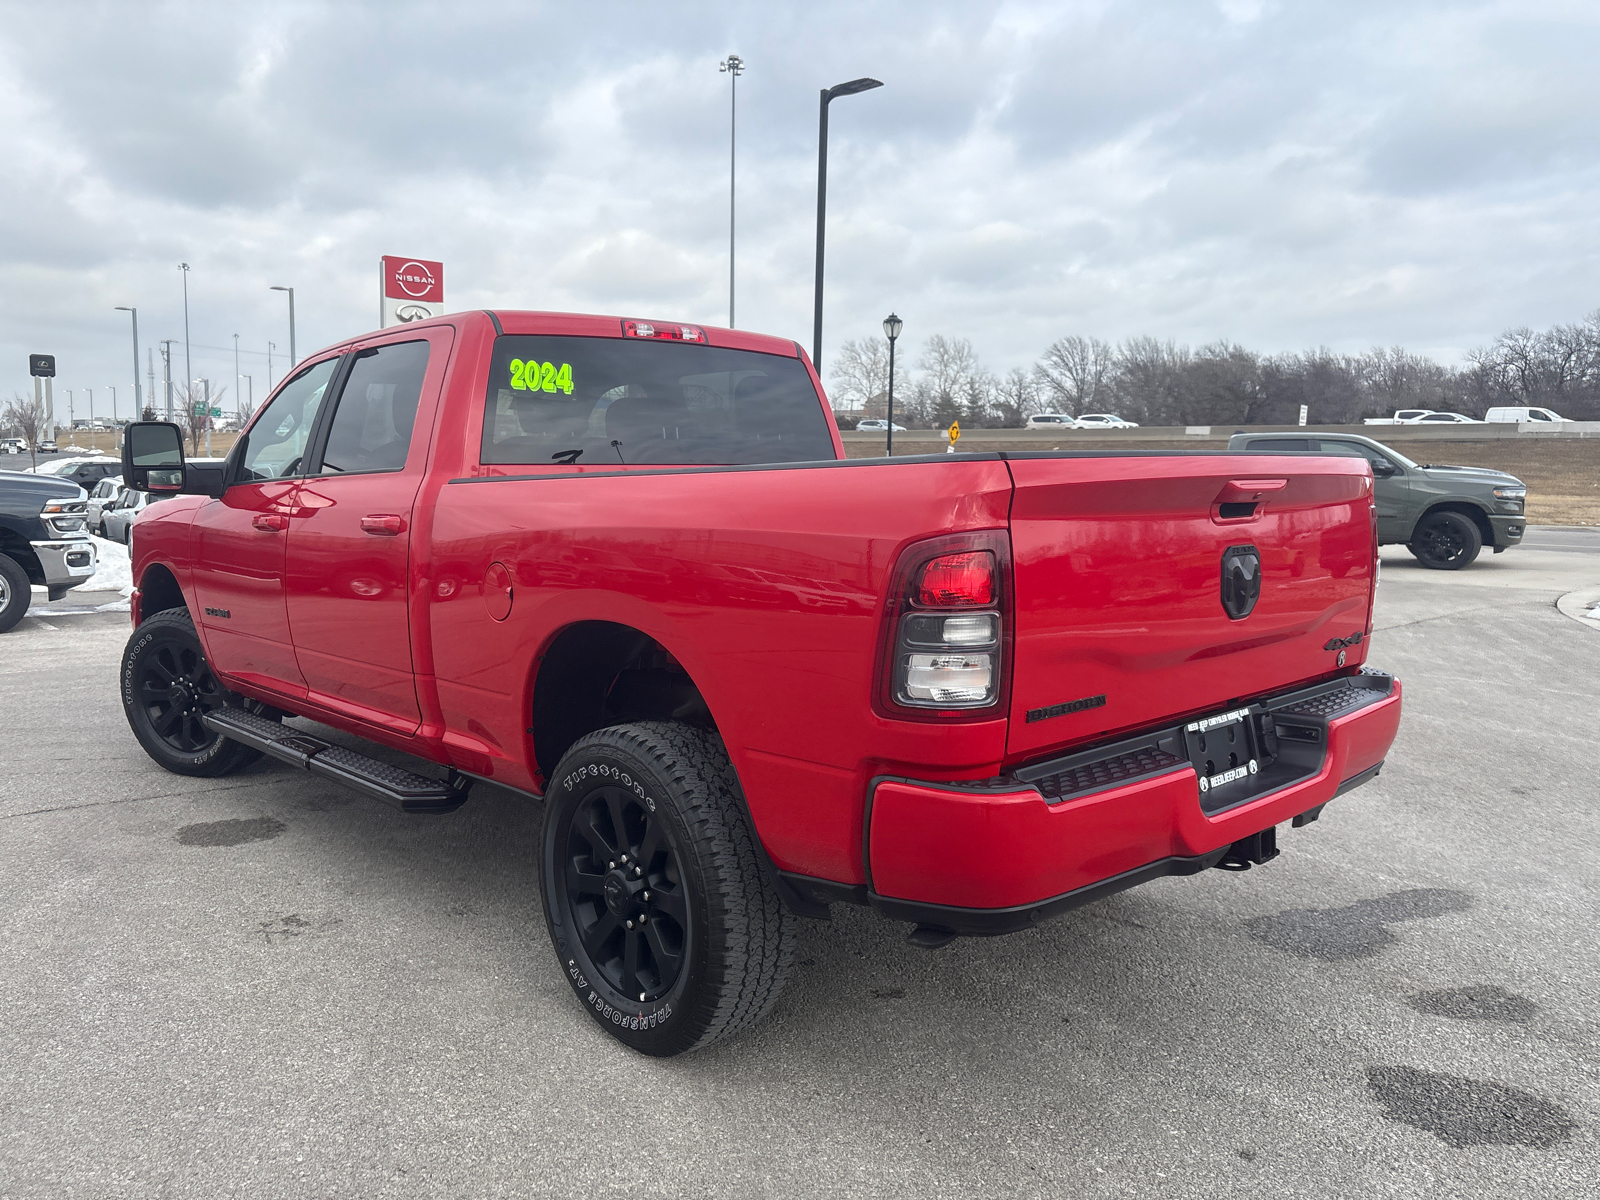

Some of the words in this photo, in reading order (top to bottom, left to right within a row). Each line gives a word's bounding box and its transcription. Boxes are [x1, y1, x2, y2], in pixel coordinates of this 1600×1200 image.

[395, 273, 435, 285] NISSAN
[510, 358, 574, 395] 2024
[1208, 715, 1227, 726] CHRYSLER
[1227, 711, 1240, 721] DODGE
[1210, 766, 1248, 788] REEDJEEP.COM
[587, 990, 673, 1031] TRANSFORCE
